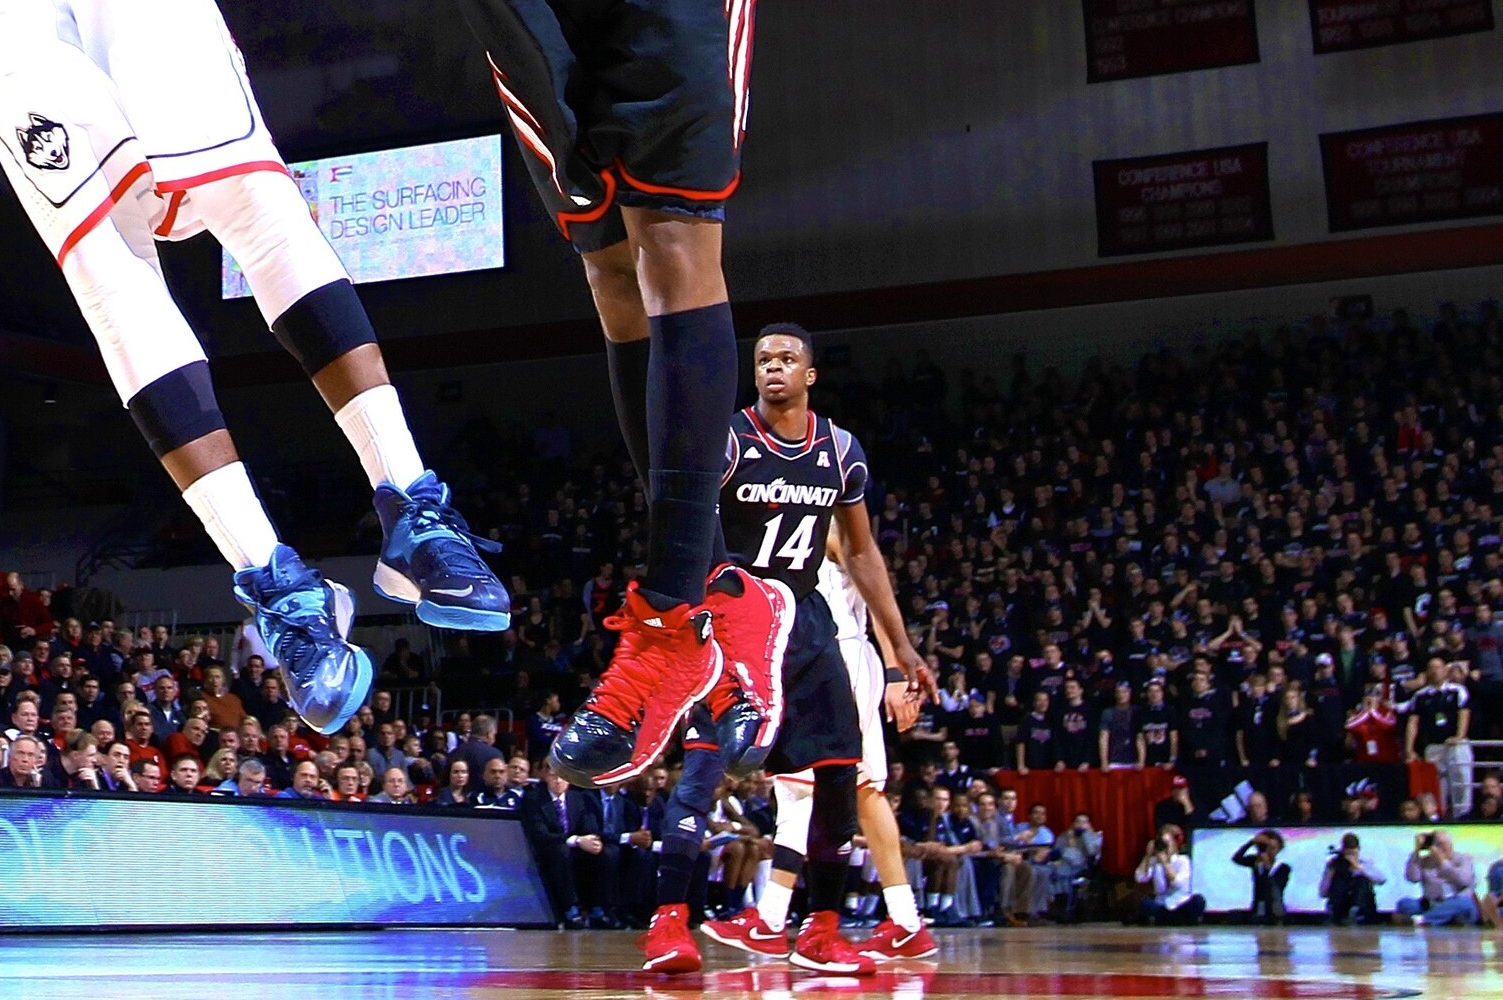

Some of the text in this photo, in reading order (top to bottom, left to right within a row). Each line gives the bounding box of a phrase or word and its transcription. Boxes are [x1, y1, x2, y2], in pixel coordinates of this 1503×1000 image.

[330, 177, 487, 215] THE SURFACING
[330, 202, 486, 240] DESIGN LEADER
[736, 480, 838, 508] CINCINNATI
[752, 513, 817, 570] 14
[246, 826, 487, 903] LUTIONS
